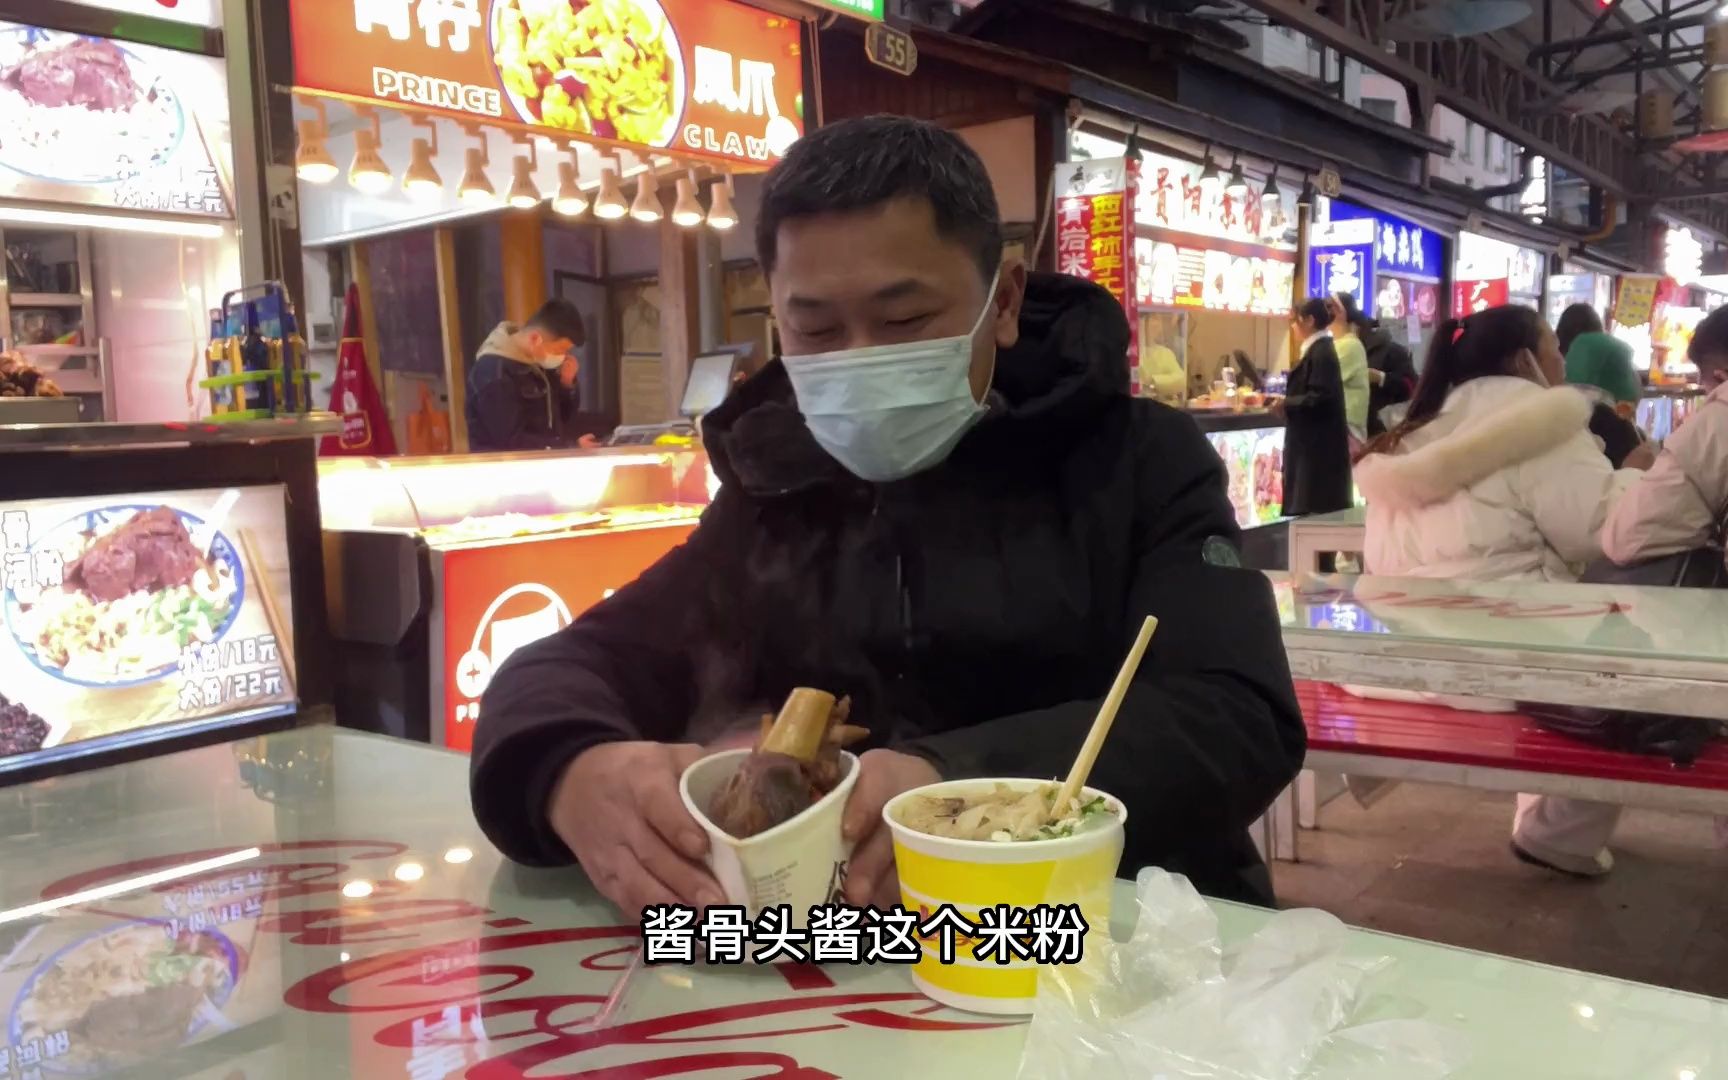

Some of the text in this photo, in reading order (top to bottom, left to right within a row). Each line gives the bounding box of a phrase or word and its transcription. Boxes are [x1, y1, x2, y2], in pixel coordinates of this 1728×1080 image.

[885, 33, 905, 66] 55
[373, 66, 502, 117] PRINCE
[178, 667, 283, 711] 大份/22元
